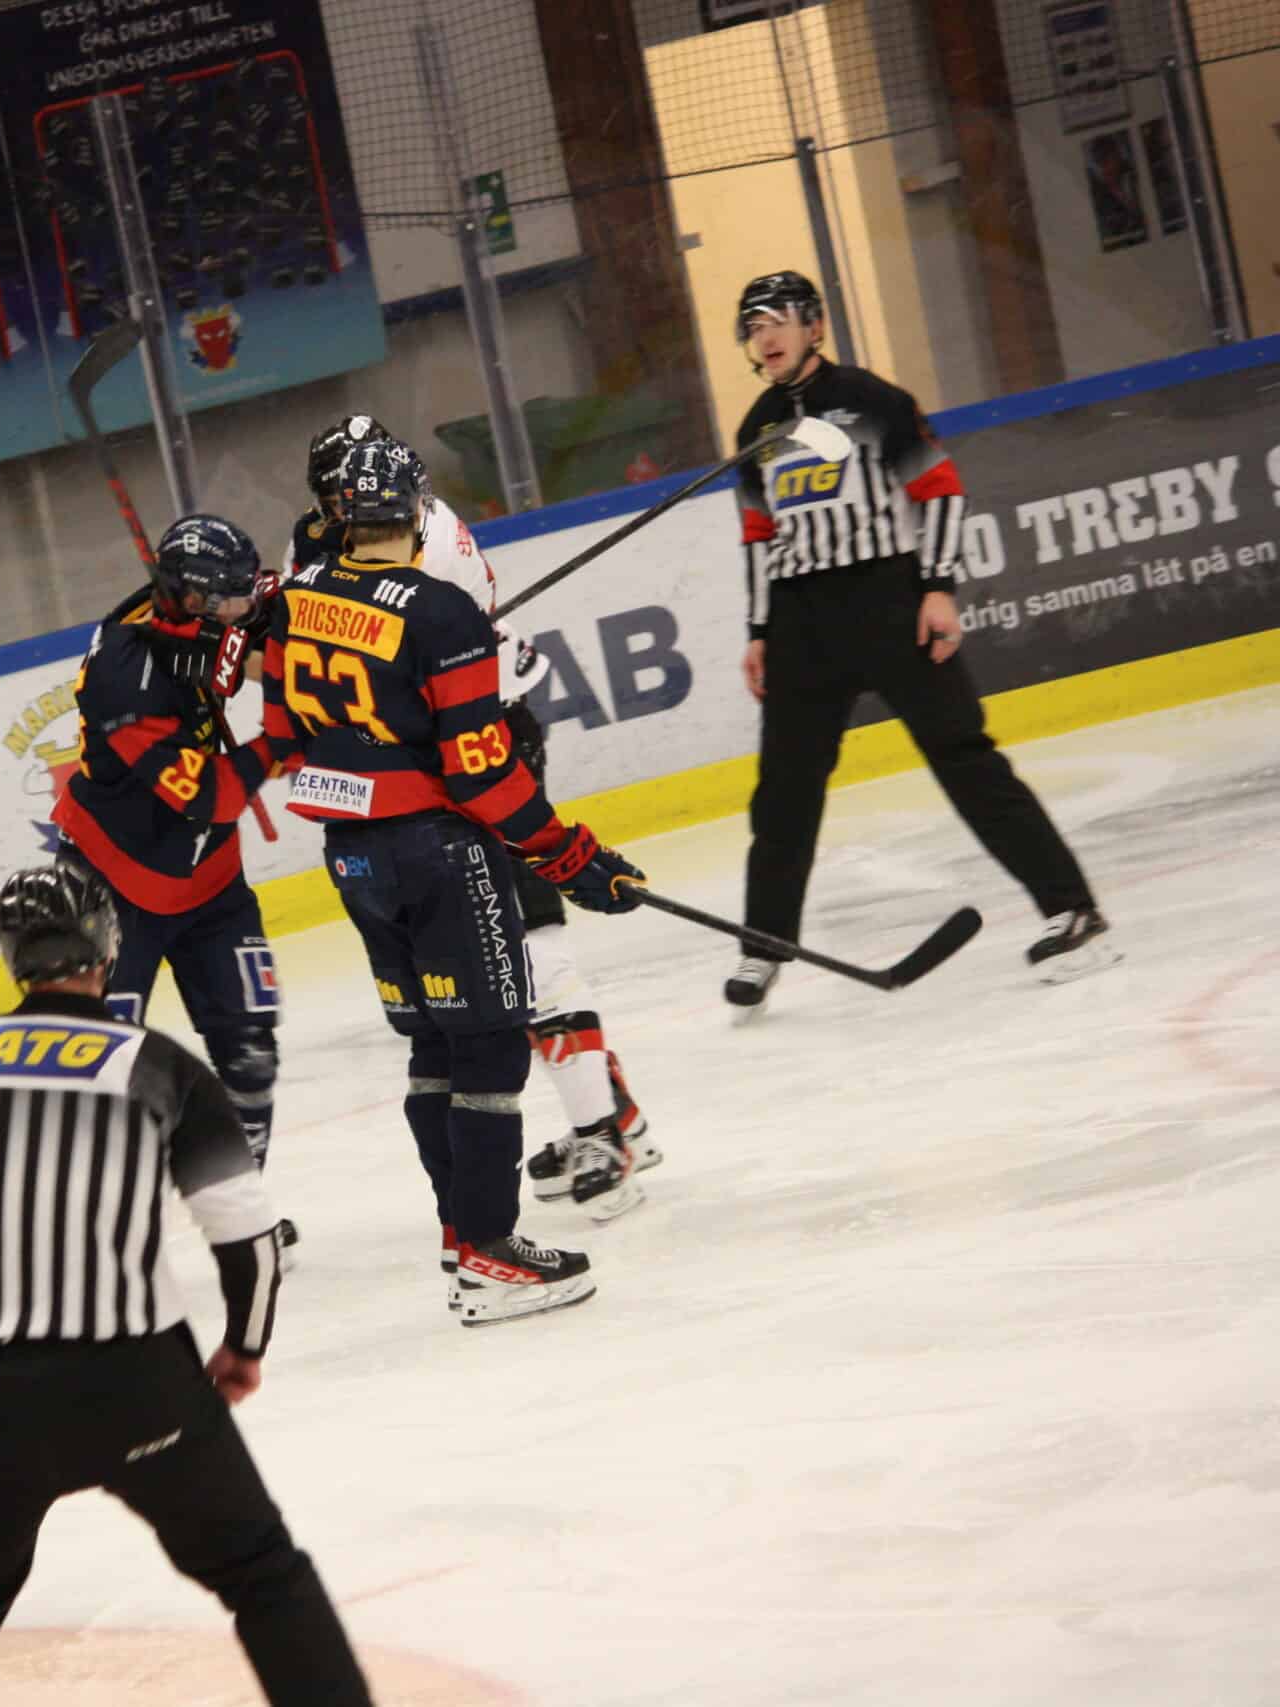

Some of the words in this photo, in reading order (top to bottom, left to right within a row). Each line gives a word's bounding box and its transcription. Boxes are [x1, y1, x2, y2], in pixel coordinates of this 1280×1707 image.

[189, 0, 232, 25] TILL
[357, 476, 378, 492] 63
[775, 463, 841, 498] ATG
[1015, 456, 1240, 564] TREBY
[330, 569, 361, 582] CCM
[959, 600, 1020, 632] drig
[1025, 572, 1138, 617] samma
[1142, 561, 1185, 589] låt
[1189, 545, 1231, 584] på
[1236, 541, 1277, 567] en
[291, 597, 386, 648] RICSSON
[283, 640, 401, 744] 63
[158, 747, 206, 802] 64
[456, 723, 511, 775] 63
[467, 843, 519, 1011] STENMARKS
